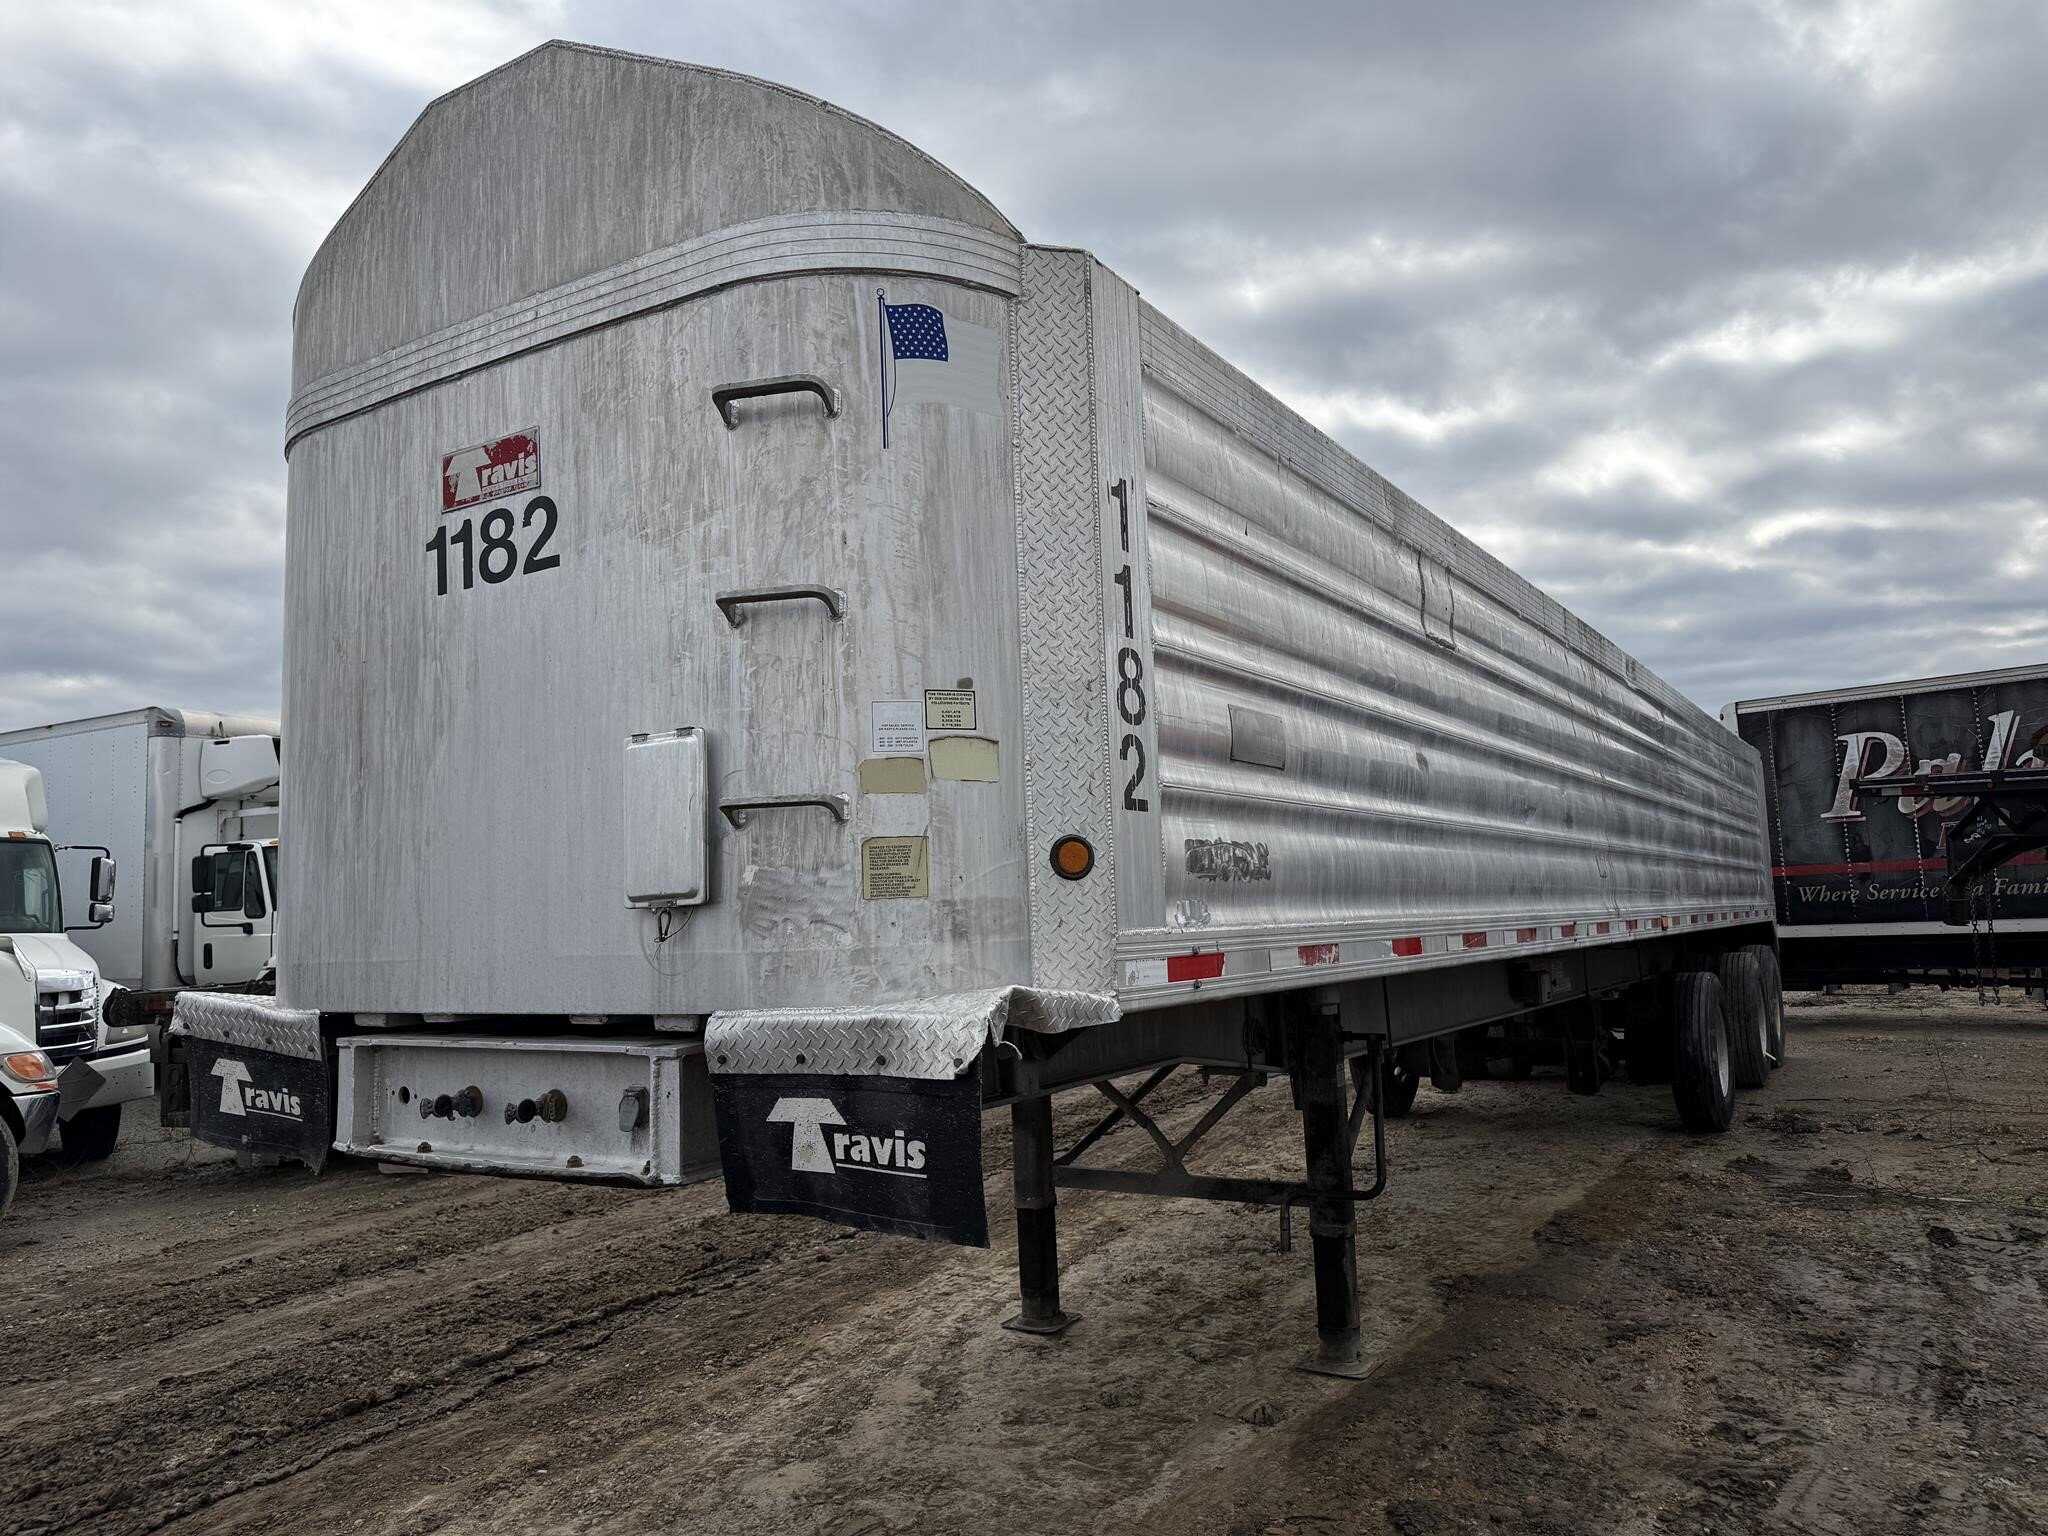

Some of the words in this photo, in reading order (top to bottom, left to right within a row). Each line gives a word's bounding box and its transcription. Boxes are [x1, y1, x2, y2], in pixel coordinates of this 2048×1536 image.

[445, 446, 537, 501] Travis
[425, 495, 560, 596] 1182
[1799, 885, 1860, 902] Where
[1866, 882, 1941, 900] Service
[210, 1057, 302, 1117] Travis
[766, 1097, 927, 1175] Travis
